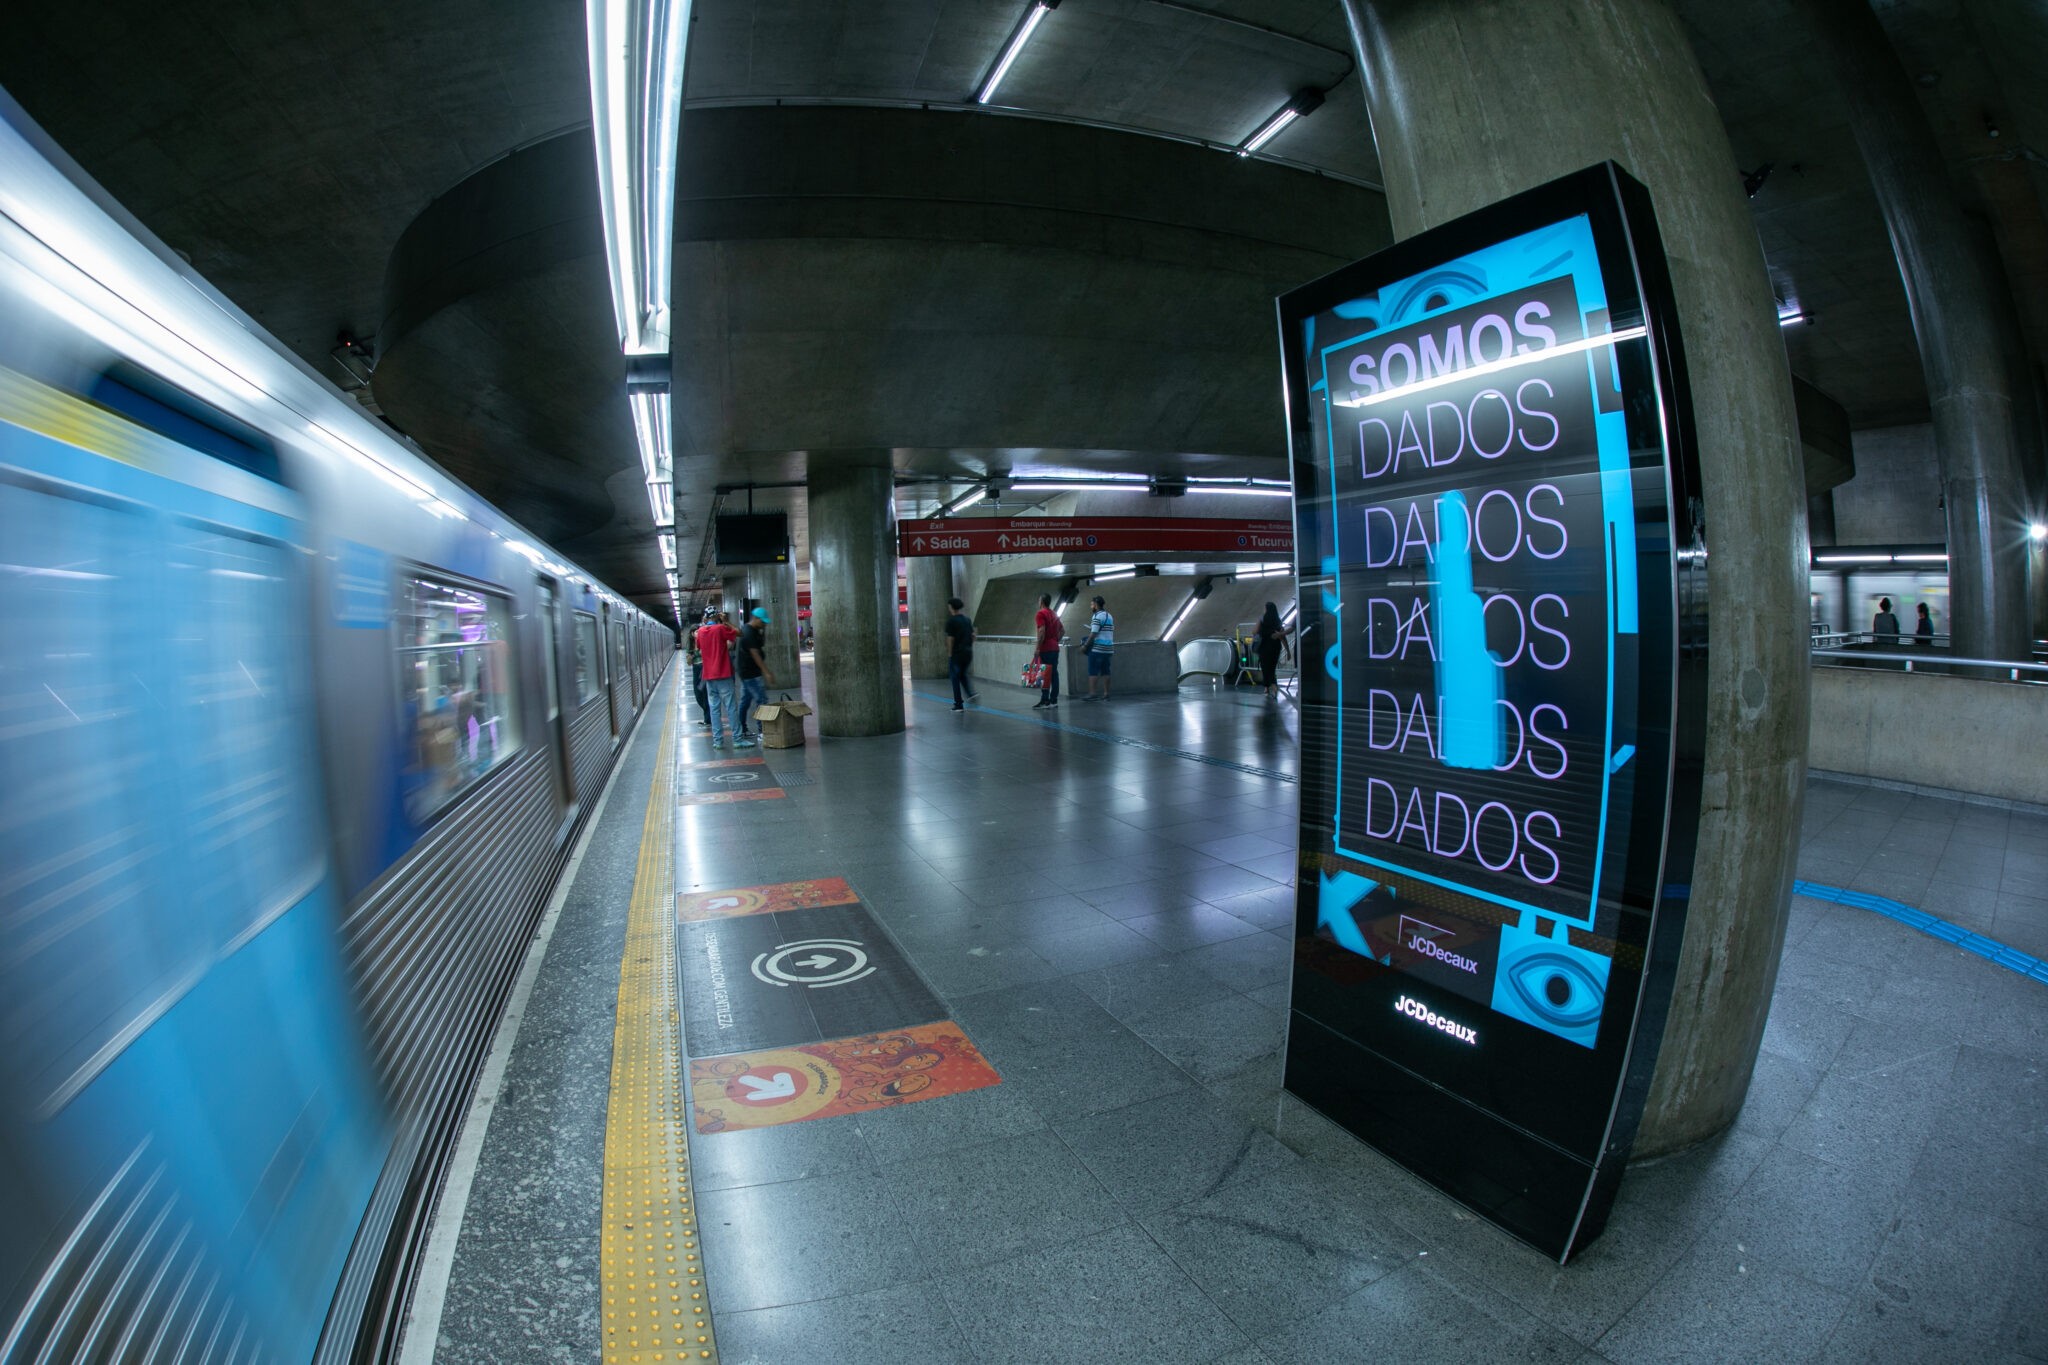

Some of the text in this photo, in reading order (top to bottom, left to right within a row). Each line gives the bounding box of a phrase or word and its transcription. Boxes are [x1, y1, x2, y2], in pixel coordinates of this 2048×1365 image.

[1349, 301, 1557, 402] SOMOS
[1358, 378, 1560, 480] DADOS
[929, 522, 945, 530] Exit
[930, 535, 970, 549] Saída
[1010, 520, 1046, 528] Embarque
[1012, 534, 1084, 549] Jabaquara
[1366, 777, 1562, 885] DADOS
[1408, 935, 1479, 975] JCDecaux
[712, 973, 726, 990] COM
[714, 989, 734, 1030] GENTILEZA
[1394, 995, 1477, 1045] JCDecaux
